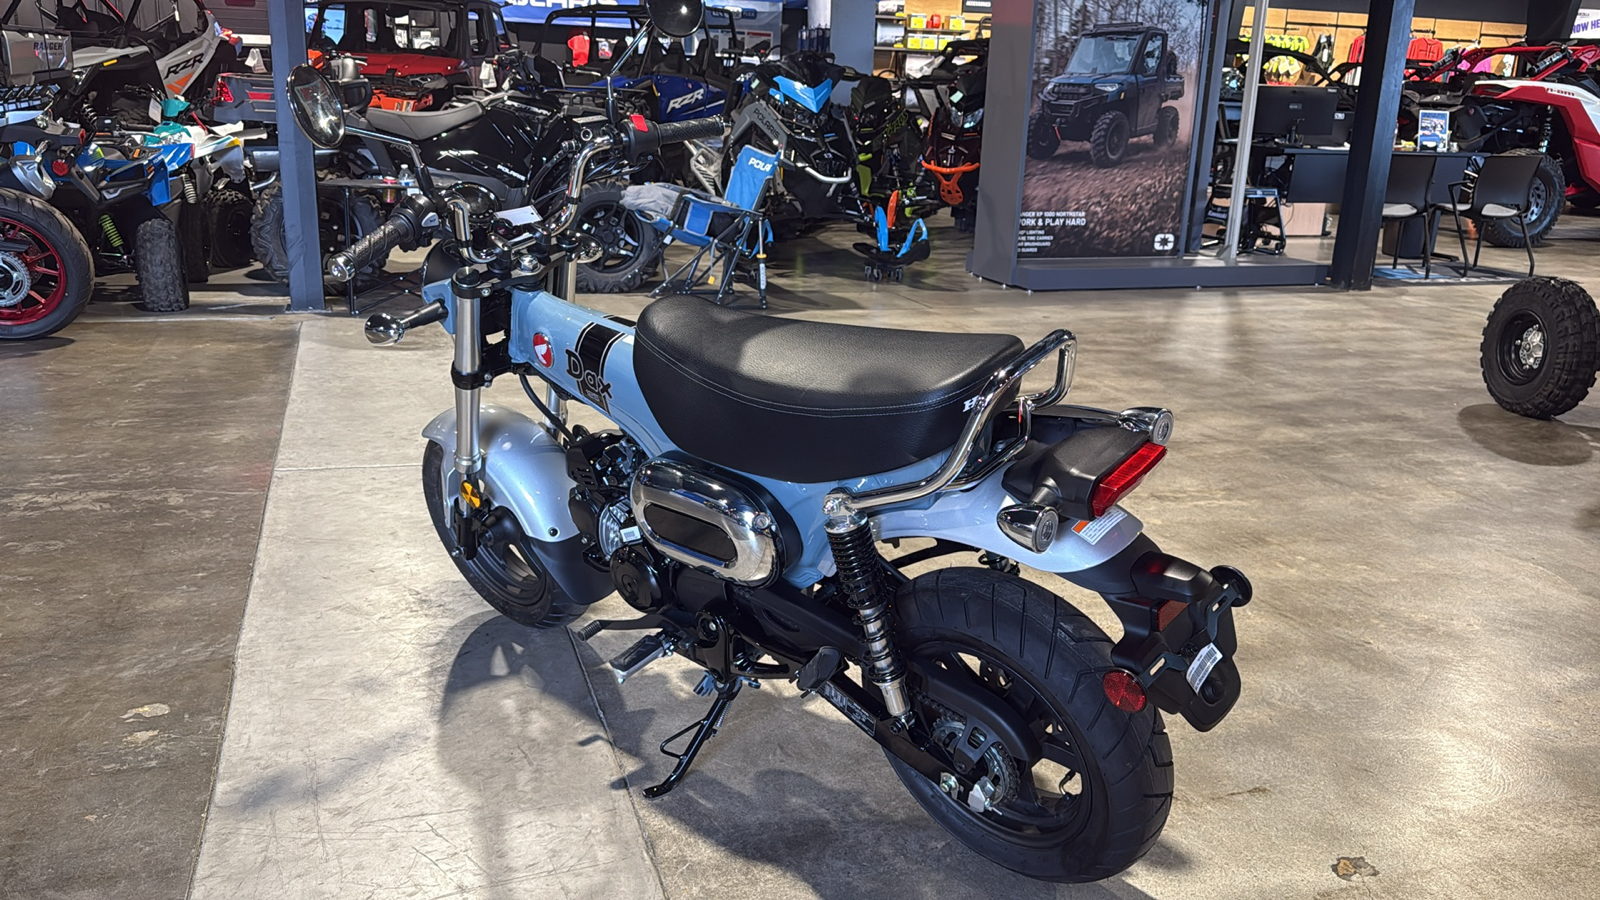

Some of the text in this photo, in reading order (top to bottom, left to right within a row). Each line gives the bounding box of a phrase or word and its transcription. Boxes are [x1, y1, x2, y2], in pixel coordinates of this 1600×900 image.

[33, 42, 63, 51] RAGER
[163, 52, 205, 80] RZR
[666, 88, 705, 114] RZR
[753, 107, 781, 138] POLARIS
[1037, 218, 1043, 226] &
[1045, 218, 1065, 226] PLAY
[1065, 218, 1086, 226] HARD
[564, 348, 614, 400] Dax
